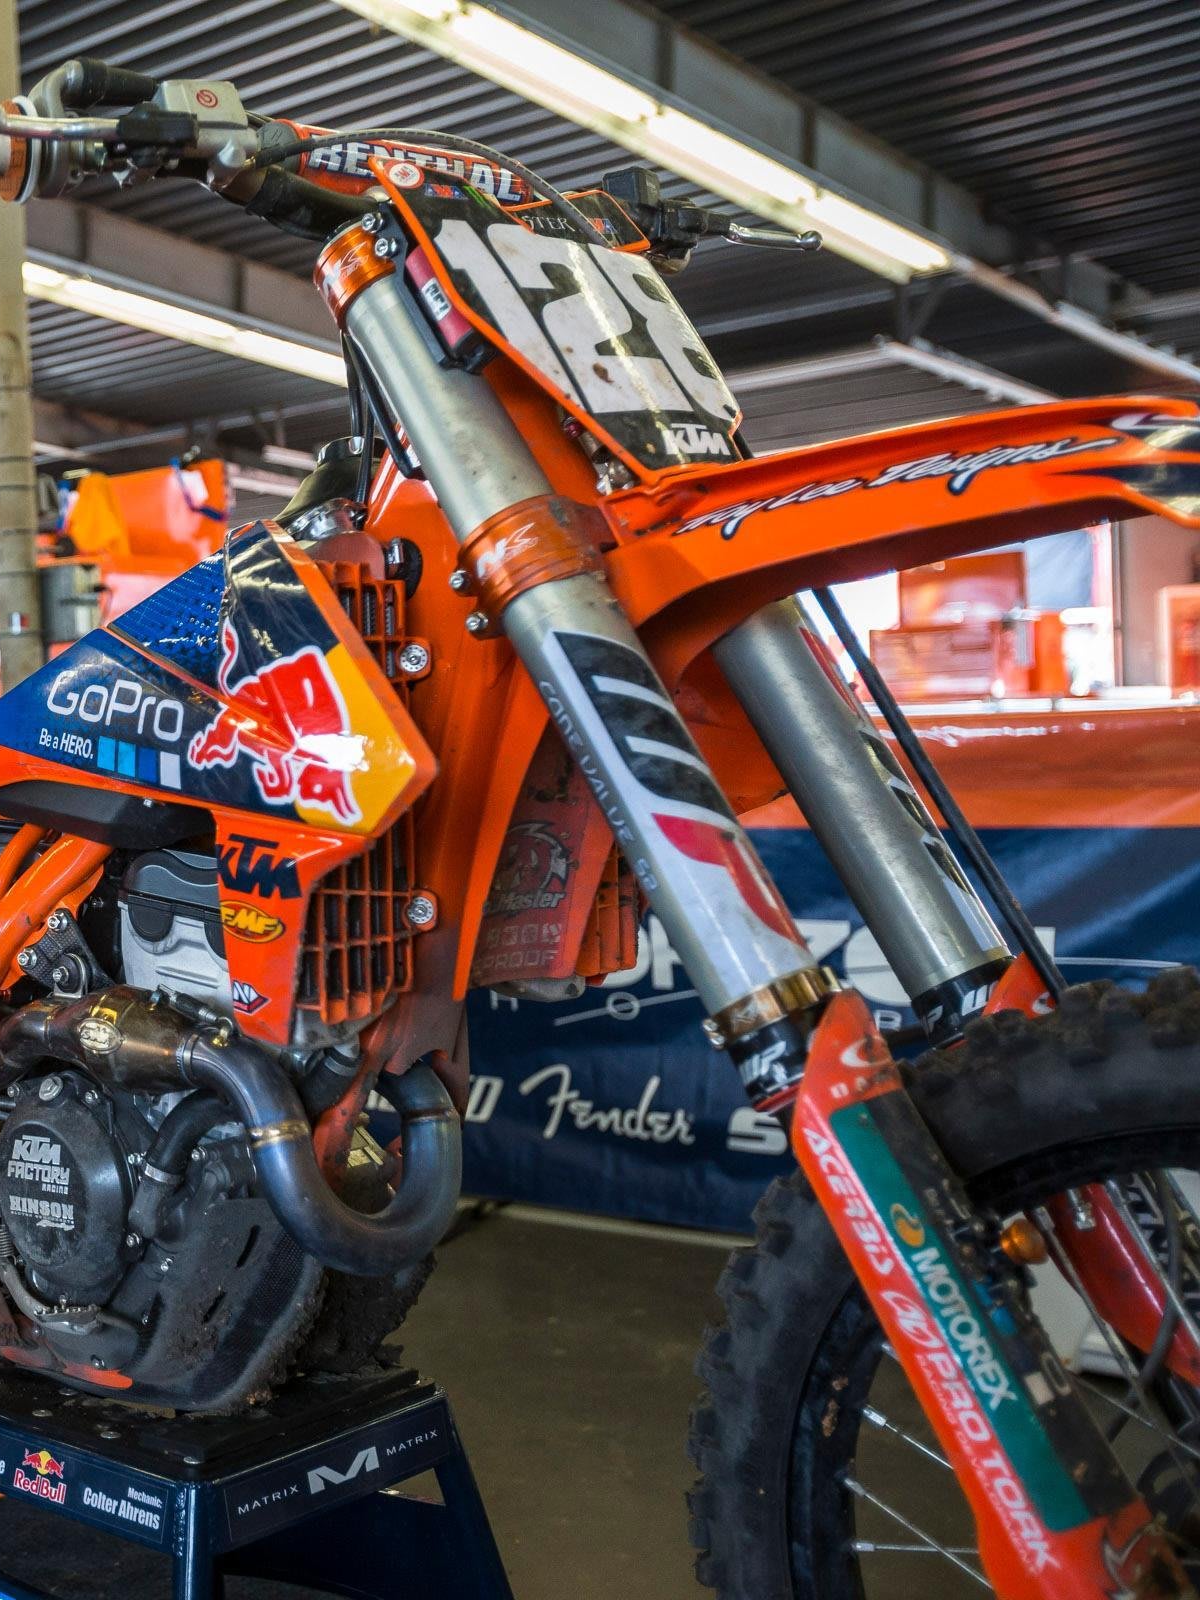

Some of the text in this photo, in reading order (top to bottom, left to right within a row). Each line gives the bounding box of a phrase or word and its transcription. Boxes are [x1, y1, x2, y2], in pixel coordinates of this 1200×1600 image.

[521, 215, 576, 232] STER
[433, 219, 741, 422] 128
[662, 423, 731, 457] KTM
[47, 670, 184, 742] GoPro
[39, 728, 94, 759] Be a HERO.
[216, 833, 302, 899] KTM
[221, 906, 280, 935] FMF
[519, 1063, 696, 1147] Fender
[12, 1135, 62, 1165] KTM
[7, 1160, 70, 1185] FACTORY
[9, 1195, 74, 1220] HINSON
[802, 1126, 895, 1278] ACERBIS
[910, 1246, 1018, 1413] MOTOREX
[237, 1484, 299, 1516] MATRIX
[386, 1428, 439, 1457] MATRIX
[919, 1353, 1063, 1573] PRO TORK
[13, 1468, 67, 1505] Red Bull
[127, 1487, 163, 1509] Mechanic:
[83, 1487, 161, 1530] Colter Ahrens
